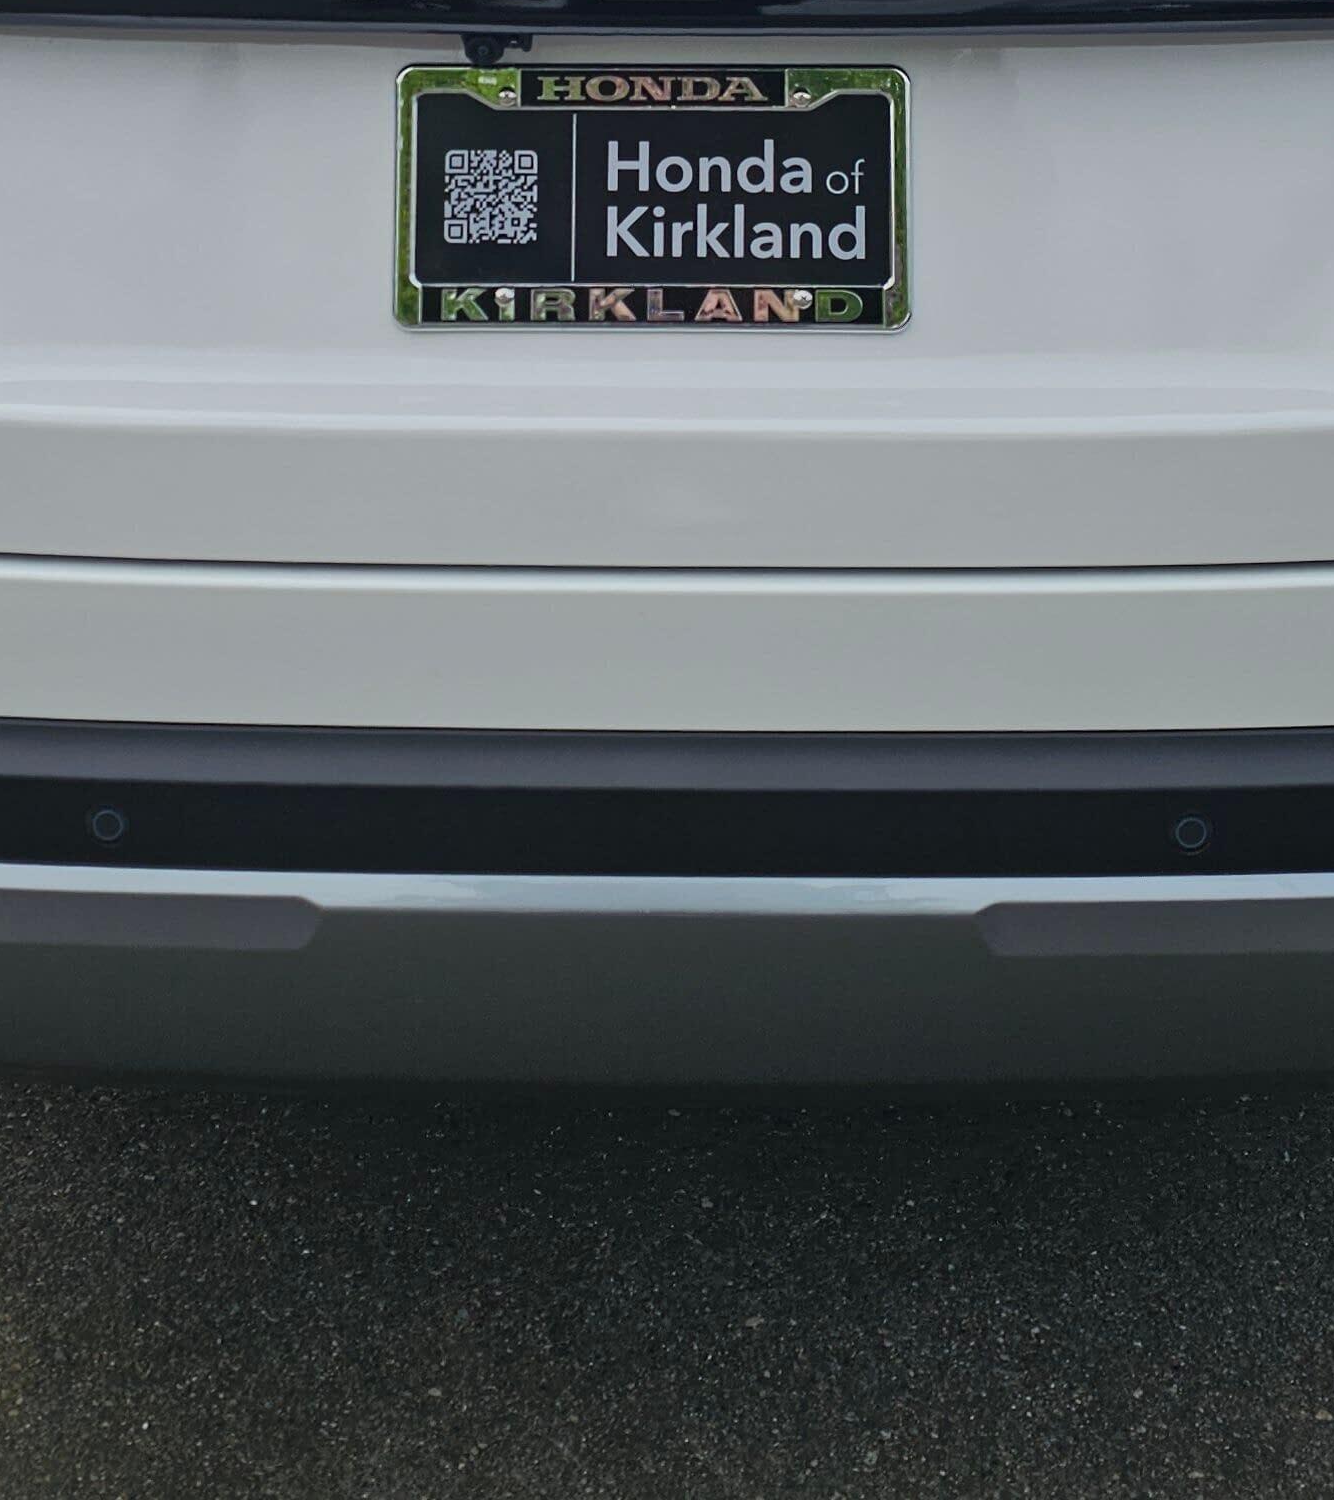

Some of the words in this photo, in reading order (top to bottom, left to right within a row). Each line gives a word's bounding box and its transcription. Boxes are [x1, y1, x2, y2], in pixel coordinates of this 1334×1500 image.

[536, 75, 769, 102] HONDA
[606, 139, 812, 194] Honda
[825, 158, 865, 195] of
[605, 204, 866, 260] Kirkland
[440, 288, 864, 323] KIRKLAND
